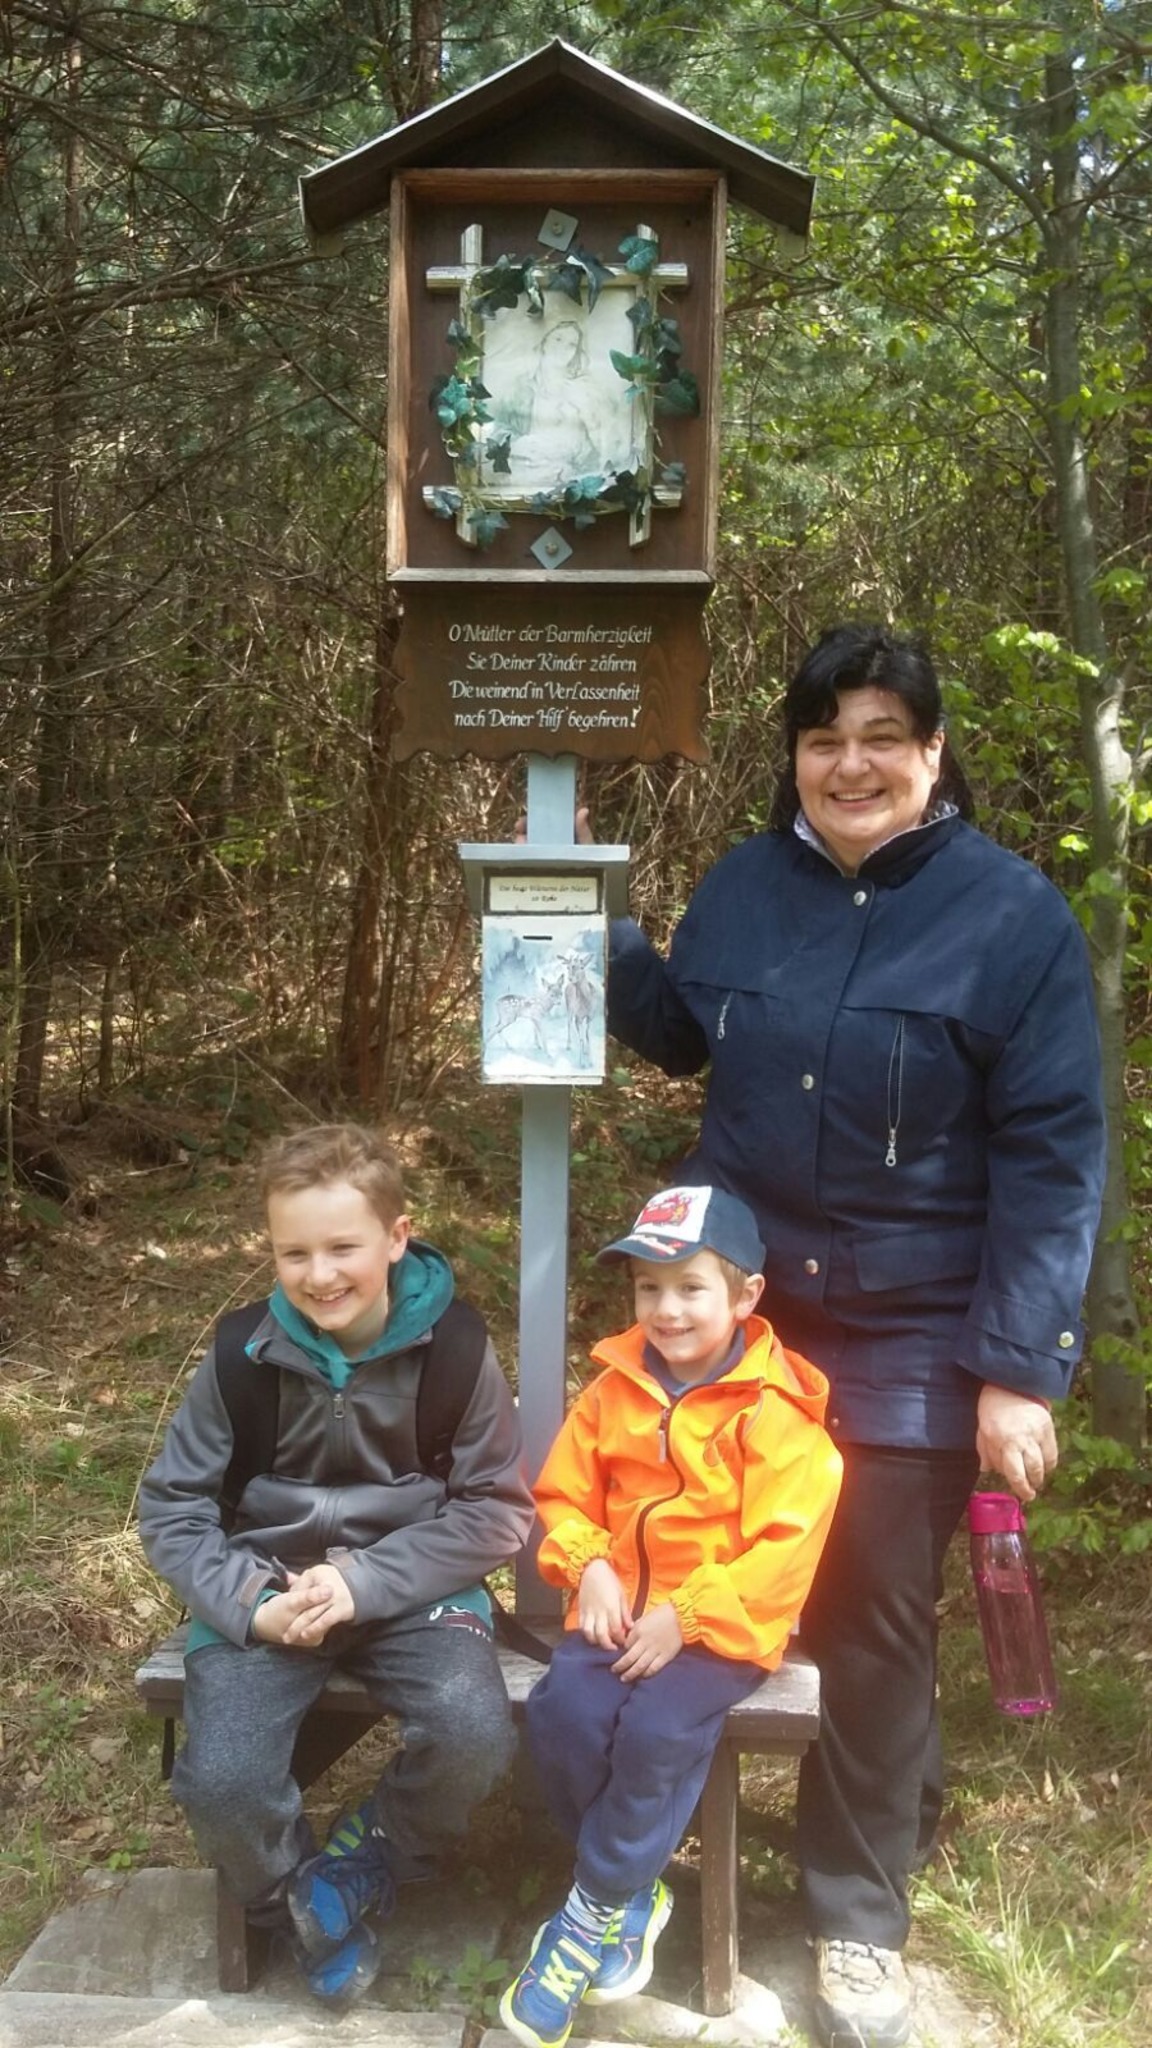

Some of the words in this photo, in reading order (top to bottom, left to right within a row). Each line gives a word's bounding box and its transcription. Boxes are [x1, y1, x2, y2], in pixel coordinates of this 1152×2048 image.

[449, 624, 461, 642] O
[519, 624, 544, 642] der
[545, 624, 652, 649] Barmherzigkeit
[466, 652, 487, 670] Sie
[489, 652, 536, 671] Deiner
[537, 652, 587, 672] Kinder
[448, 680, 474, 699] Die
[475, 680, 533, 699] weinend
[531, 681, 544, 699] in
[454, 709, 485, 727] nach
[488, 708, 535, 727] Deiner
